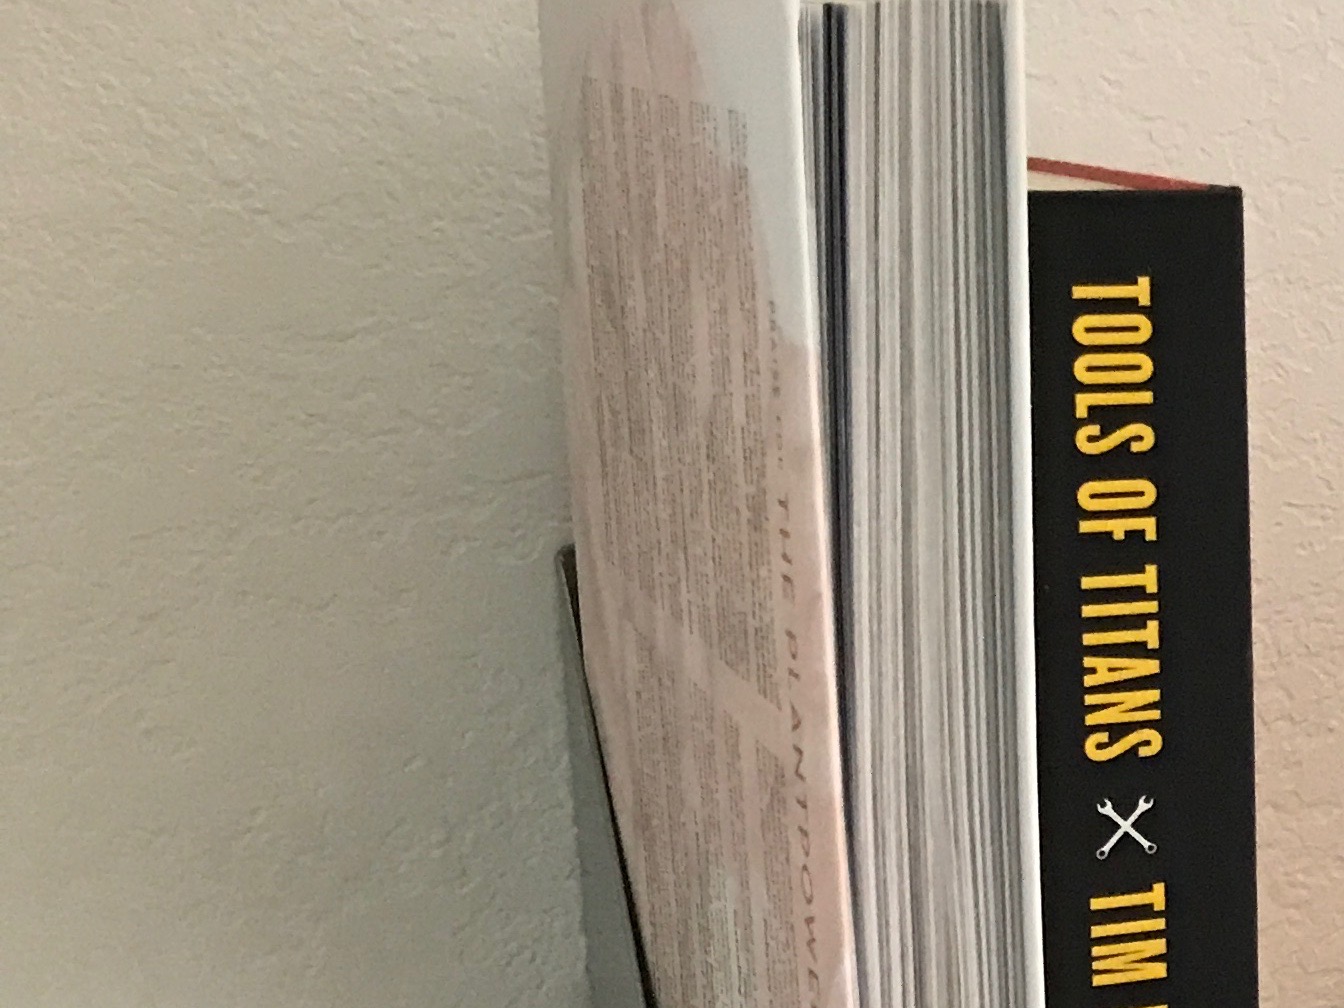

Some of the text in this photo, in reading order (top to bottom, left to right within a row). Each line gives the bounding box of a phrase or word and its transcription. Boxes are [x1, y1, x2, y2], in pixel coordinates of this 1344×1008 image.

[767, 300, 782, 398] PRAISE
[778, 497, 795, 601] THE
[1070, 275, 1163, 762] TOOLS OF TITANS
[1089, 881, 1169, 987] TIM
